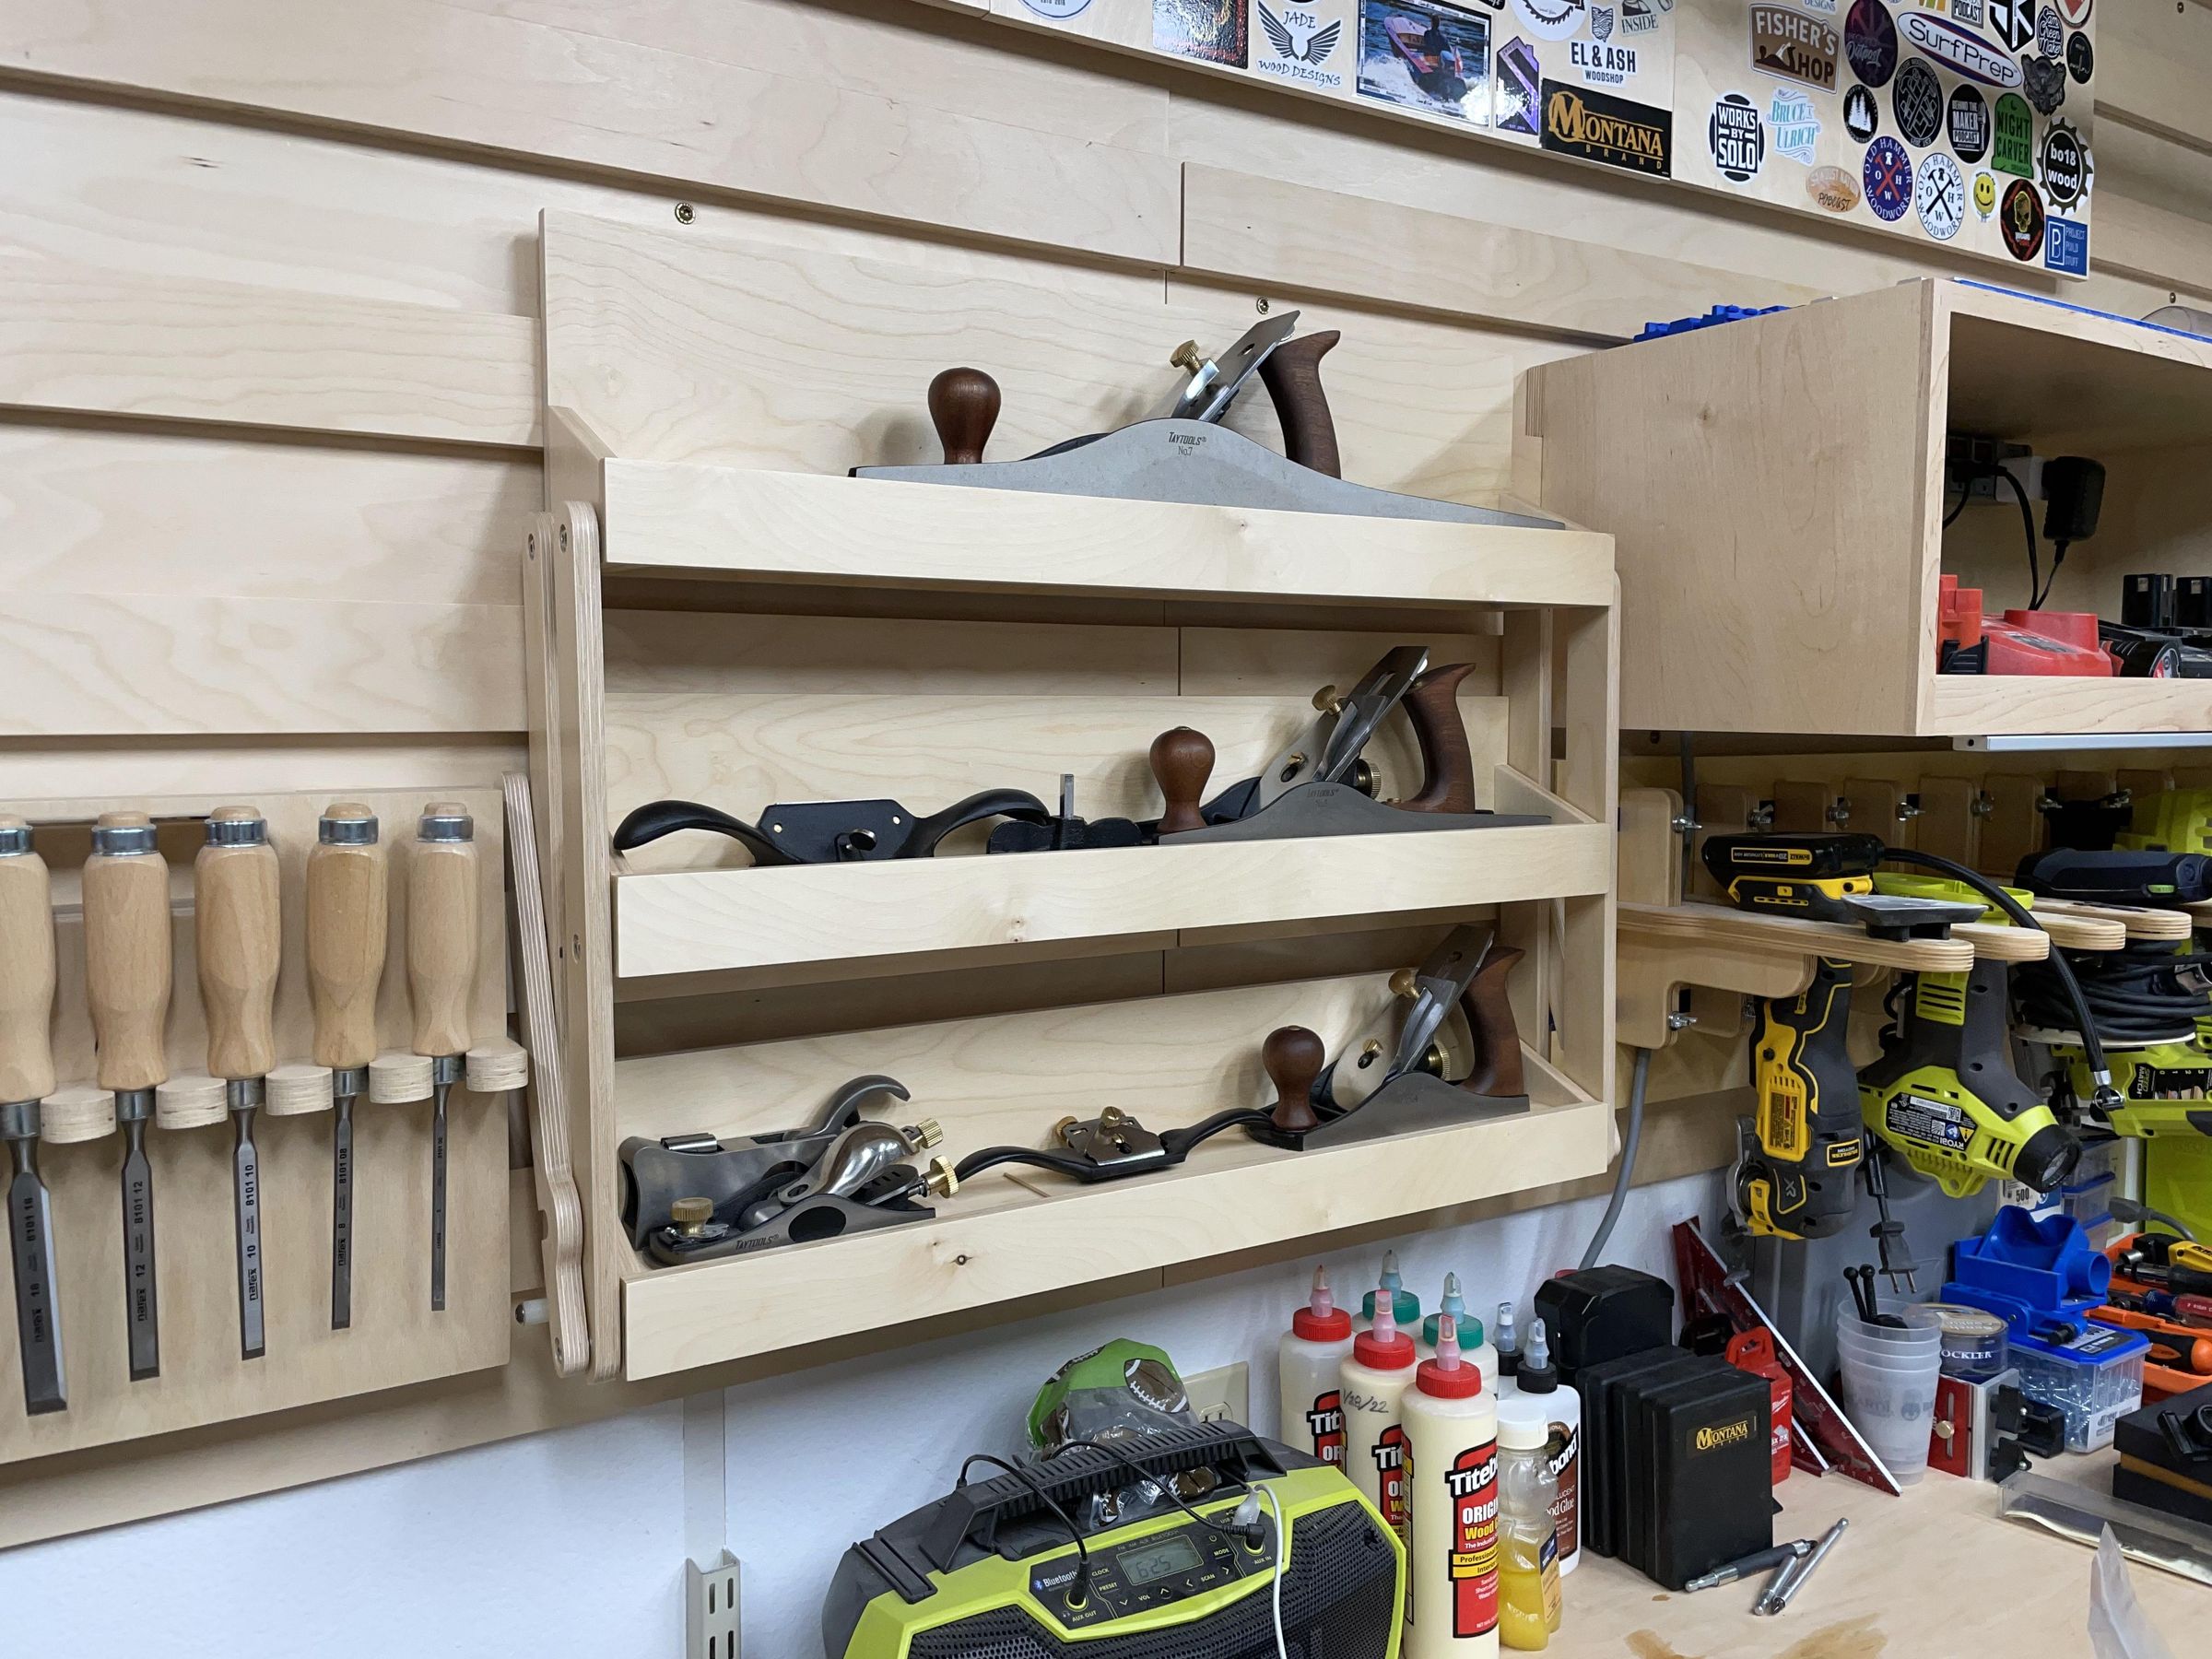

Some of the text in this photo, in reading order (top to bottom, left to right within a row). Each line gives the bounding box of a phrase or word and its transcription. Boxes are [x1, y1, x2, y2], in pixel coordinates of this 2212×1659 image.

[1283, 11, 1316, 29] JADE
[1954, 1, 1982, 22] PODCAST
[1621, 15, 1658, 33] INSIDE
[1755, 11, 1836, 55] FISHER'S
[1571, 42, 1637, 73] EL & ASH
[1258, 60, 1341, 87] WOOD DESIGNS
[1585, 70, 1624, 85] WOODSHOP
[1718, 105, 1756, 130] WORKS
[1771, 100, 1806, 123] BRUCE
[1953, 111, 1979, 130] MAKER
[1548, 91, 1664, 157] MONTANA
[1731, 128, 1745, 139] BY
[1996, 112, 2030, 139] NIGHT
[1777, 126, 1816, 148] ULRICH
[1953, 130, 1980, 144] PODCAST
[1585, 145, 1662, 170] BRAND
[1718, 137, 1756, 170] SOLO
[1996, 136, 2029, 164] CARVER
[2051, 143, 2077, 166] bo18
[1865, 138, 1912, 184] OLD HAMMER
[1875, 171, 1901, 184] O H
[1918, 155, 1963, 201] OLD HAMMER
[2048, 170, 2077, 190] wood
[1865, 185, 1911, 220] WOODWORK
[1885, 190, 1892, 201] W
[1925, 185, 1954, 204] O H
[1918, 204, 1962, 237] WOODWORK
[1936, 210, 1944, 222] W
[2136, 1065, 2146, 1095] MATCH
[339, 1147, 347, 1159] 08
[1939, 1136, 1965, 1150] RYOBI
[134, 1181, 143, 1194] 12
[1784, 1178, 1796, 1197] XR
[2016, 1187, 2030, 1202] 500
[134, 1198, 144, 1224] 8101
[25, 1215, 36, 1242] 8101
[245, 1164, 259, 1301] narex 10 8101 10
[338, 1238, 347, 1266] narex
[135, 1264, 146, 1278] 12
[136, 1288, 148, 1322] narex
[1941, 1349, 1993, 1359] OCKLER
[1696, 1421, 1748, 1450] MONTANA
[1549, 1431, 1578, 1476] bond
[1449, 1453, 1499, 1496] Titeb
[1555, 1484, 1575, 1500] LUCENT
[1463, 1497, 1499, 1525] ORIGI
[1560, 1497, 1574, 1513] Glue
[1465, 1521, 1494, 1541] Wood
[1214, 1548, 1230, 1557] MODE
[1460, 1547, 1497, 1563] Professiona
[1042, 1570, 1077, 1587] Bluetooth
[1091, 1568, 1110, 1577] CLOCK
[1201, 1573, 1216, 1583] SCAN
[1099, 1582, 1118, 1592] PRESET
[1072, 1614, 1085, 1622] AUX
